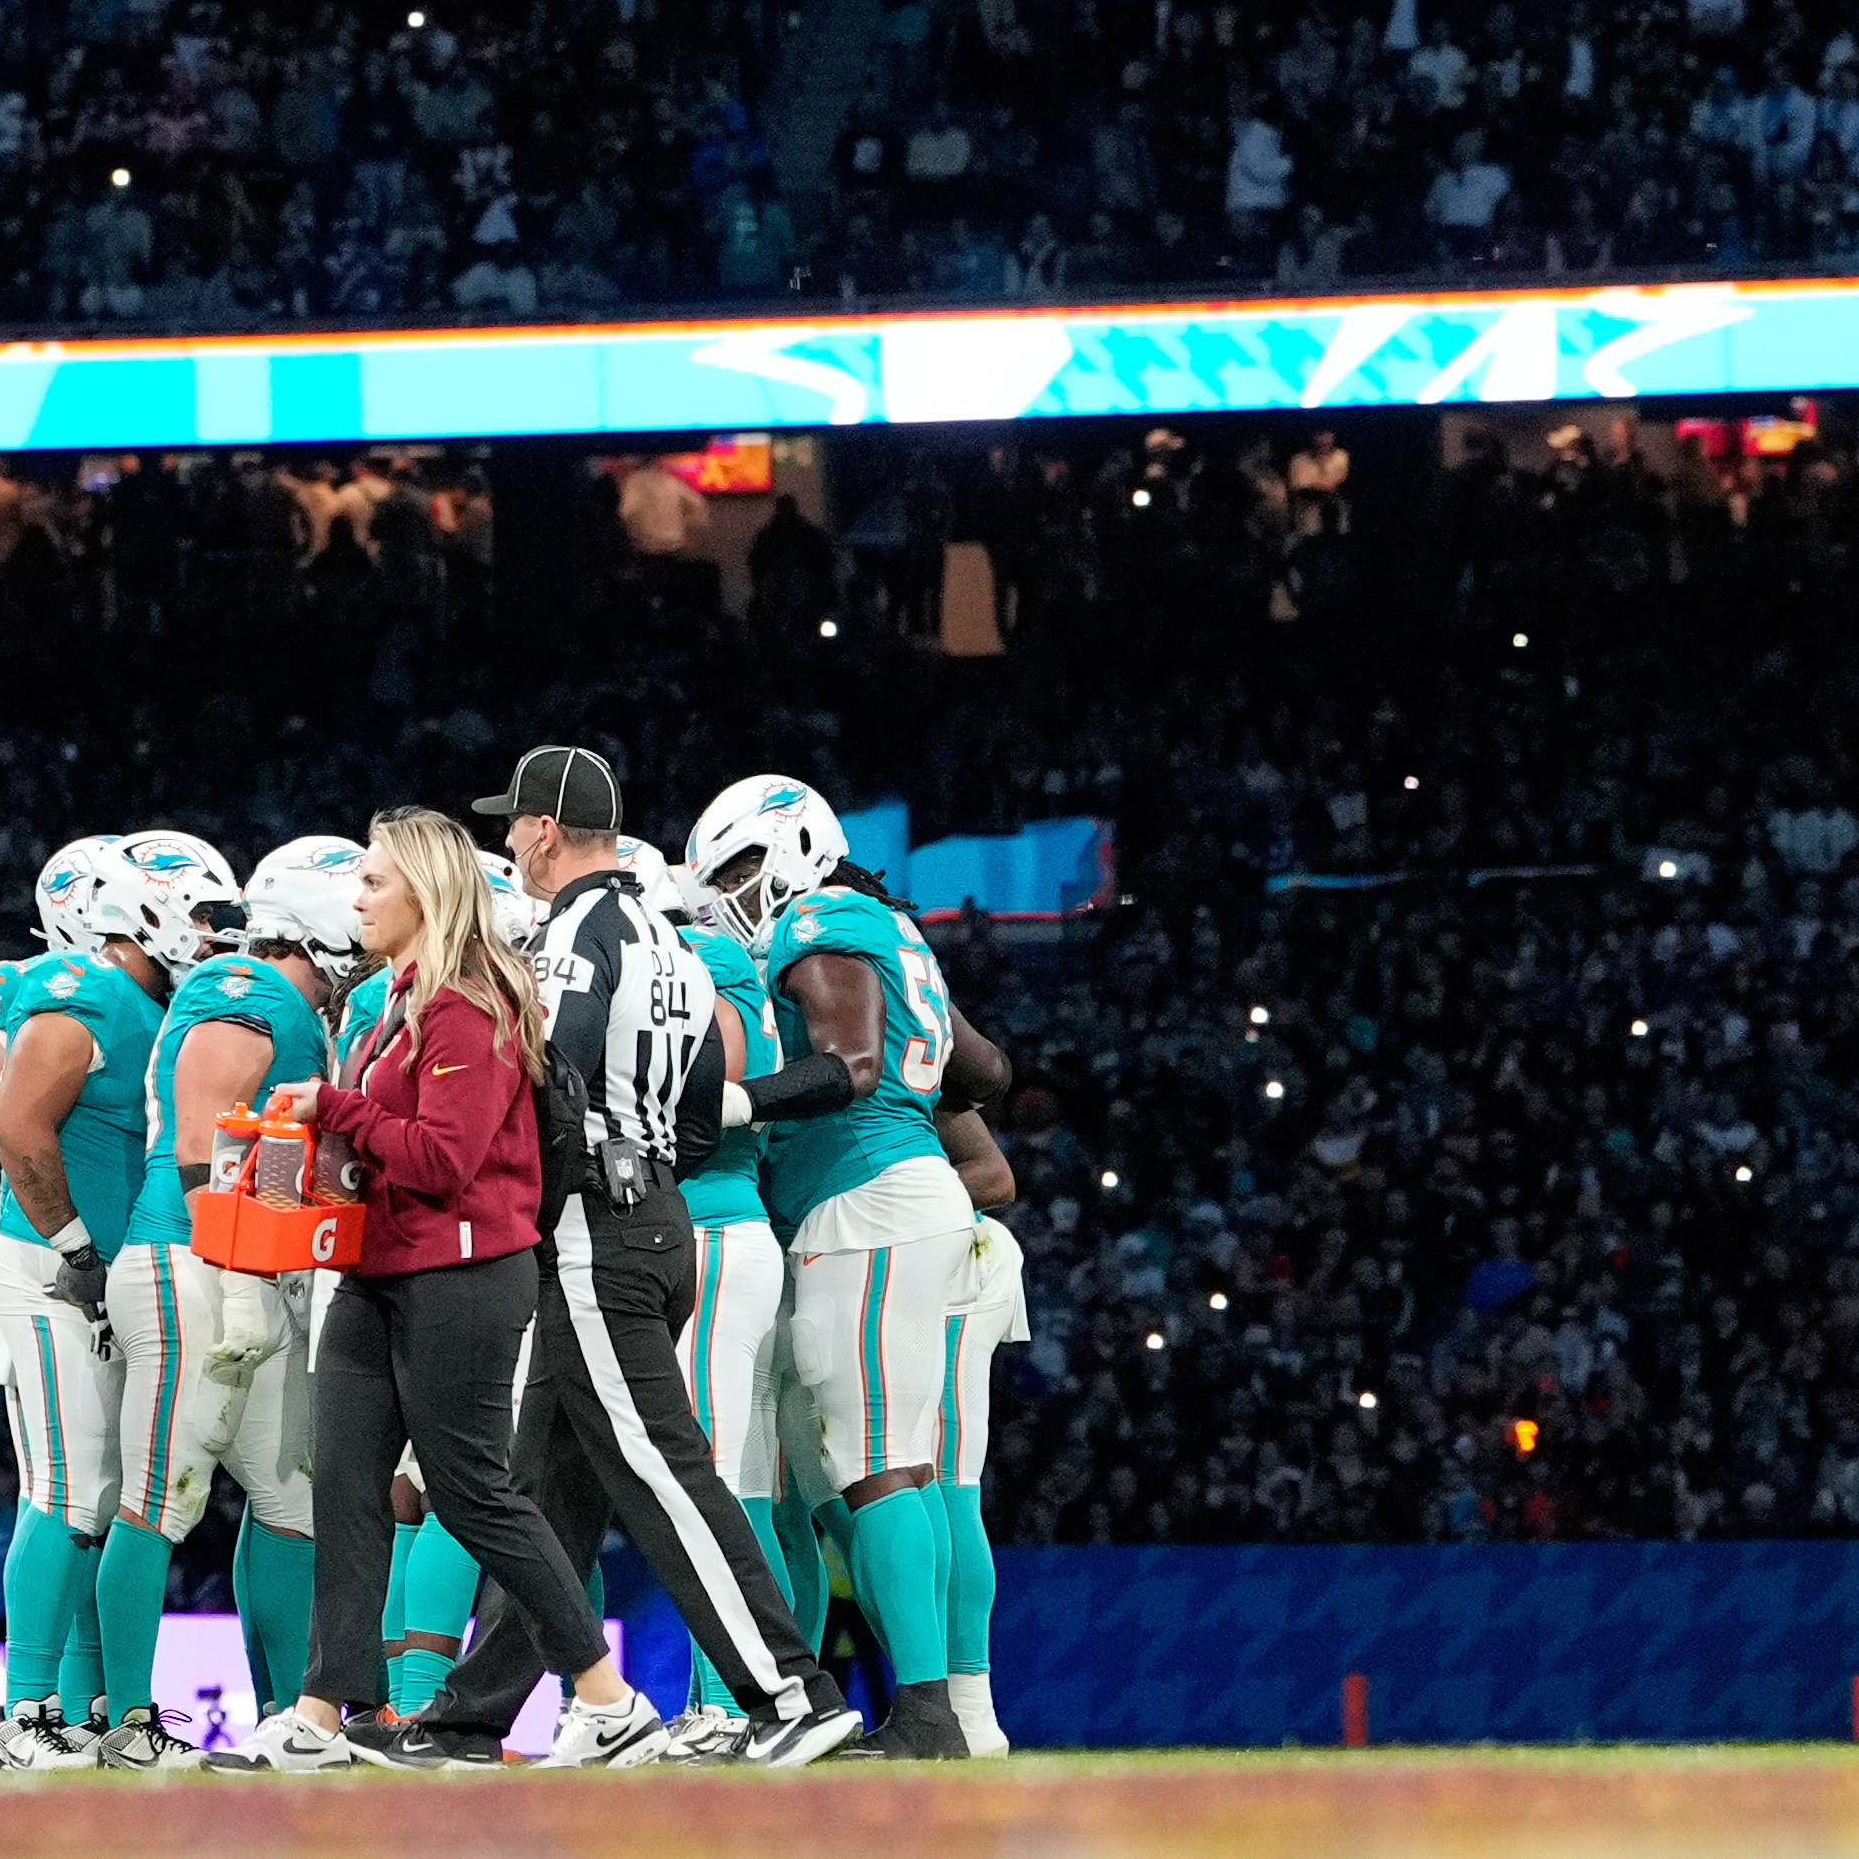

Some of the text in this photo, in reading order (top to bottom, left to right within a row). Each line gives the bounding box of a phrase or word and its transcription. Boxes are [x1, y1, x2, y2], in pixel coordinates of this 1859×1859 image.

[535, 956, 577, 986] 84
[650, 979, 691, 1029] 84
[312, 1218, 338, 1262] G
